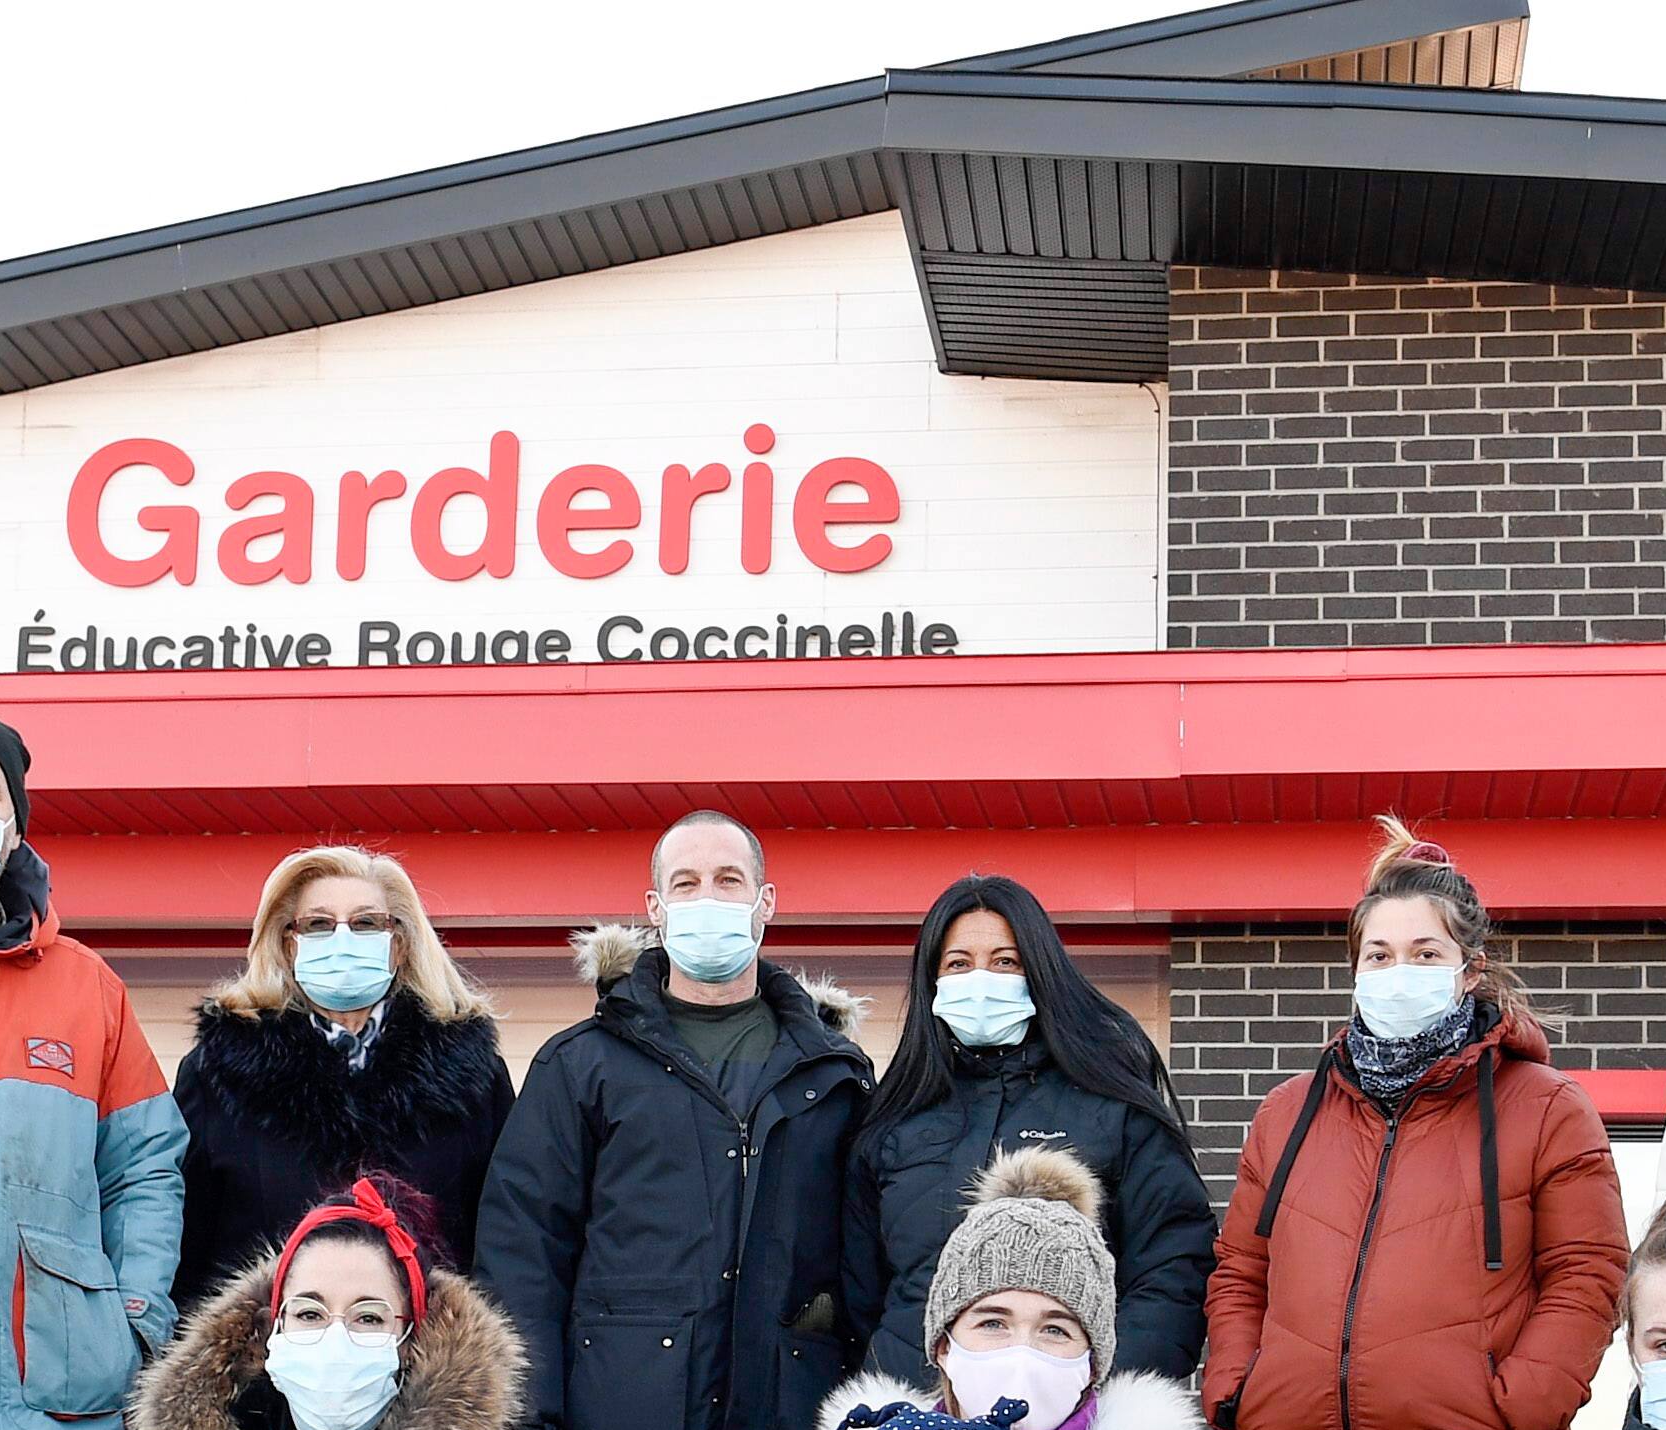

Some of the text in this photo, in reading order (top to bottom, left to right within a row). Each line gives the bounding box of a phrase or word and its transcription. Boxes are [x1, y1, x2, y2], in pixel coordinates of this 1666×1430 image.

[66, 423, 900, 588] Garderie
[15, 608, 332, 673] Éducative
[595, 611, 960, 663] Coccinelle
